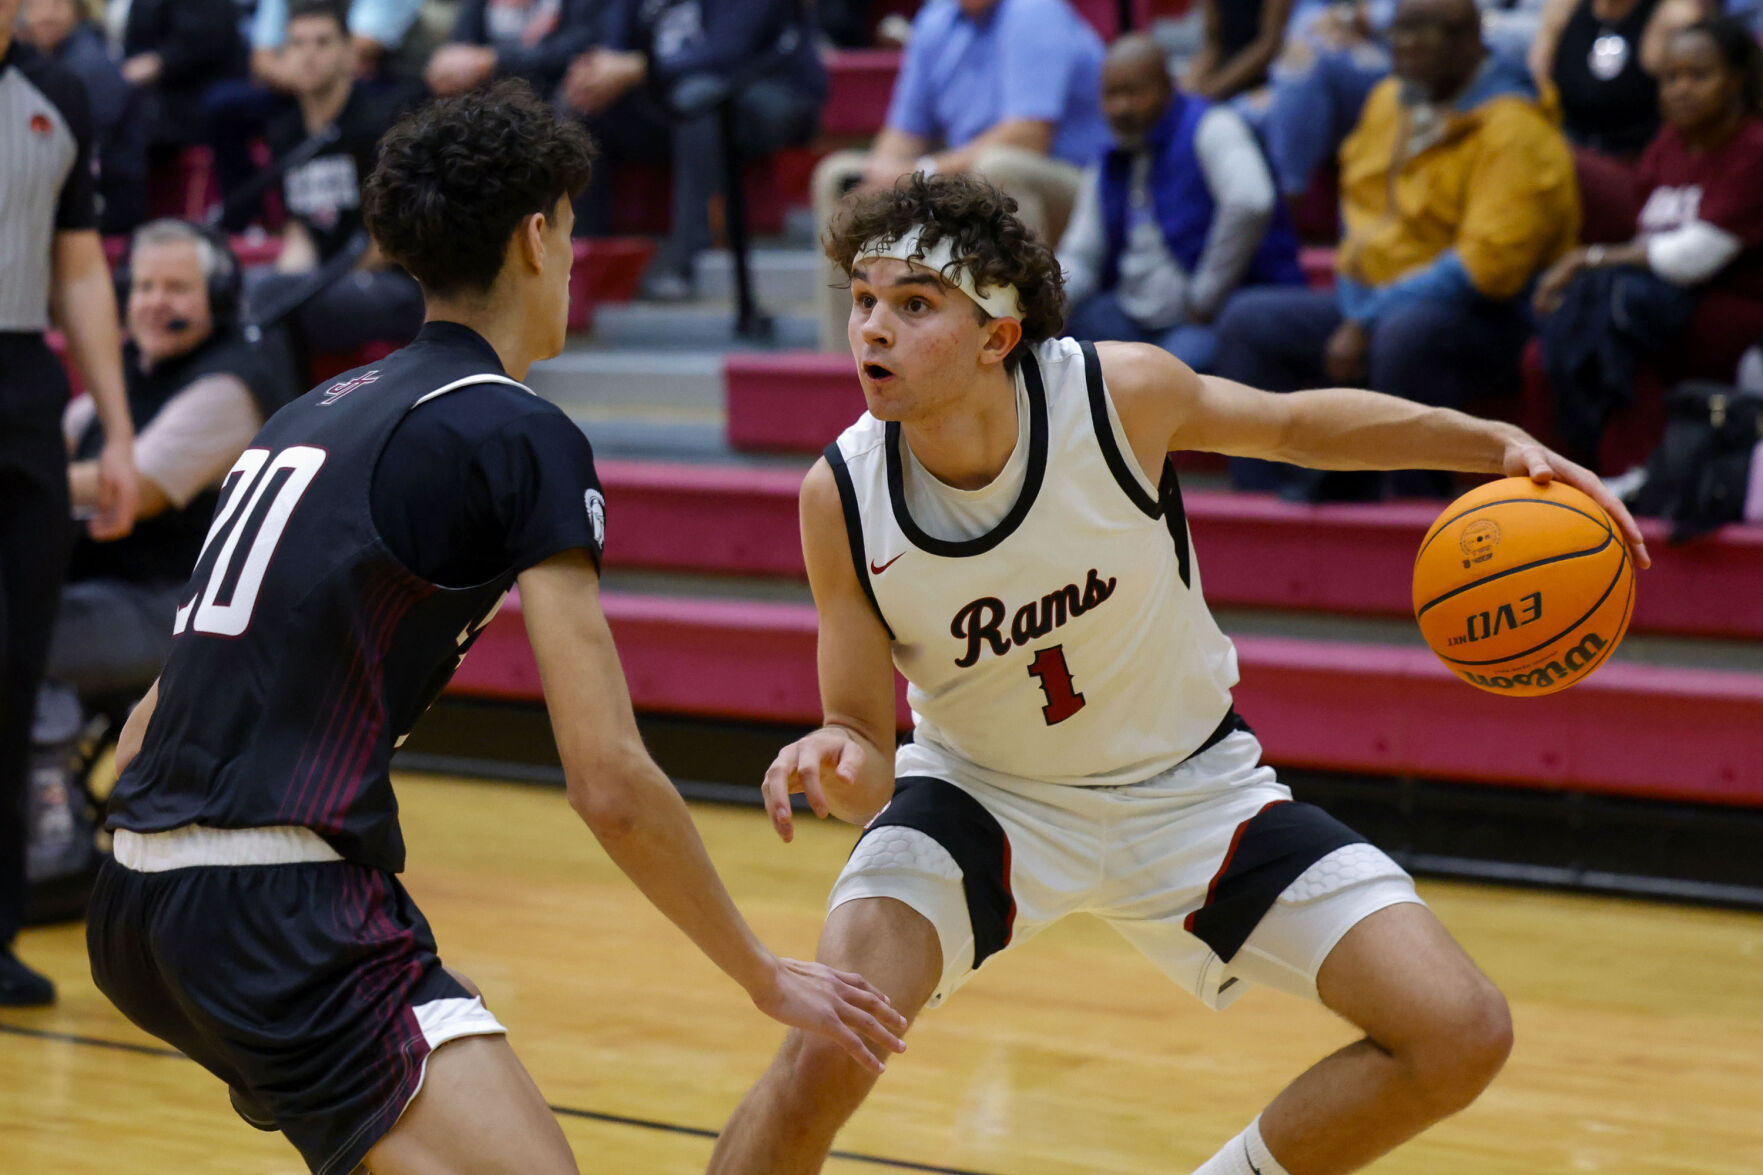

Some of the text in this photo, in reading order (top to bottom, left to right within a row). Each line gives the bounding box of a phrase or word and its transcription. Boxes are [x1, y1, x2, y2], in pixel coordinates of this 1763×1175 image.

[951, 568, 1117, 668] Rams
[1467, 591, 1542, 642] EVO
[1027, 644, 1086, 726] 1
[1460, 632, 1608, 689] Wilson
